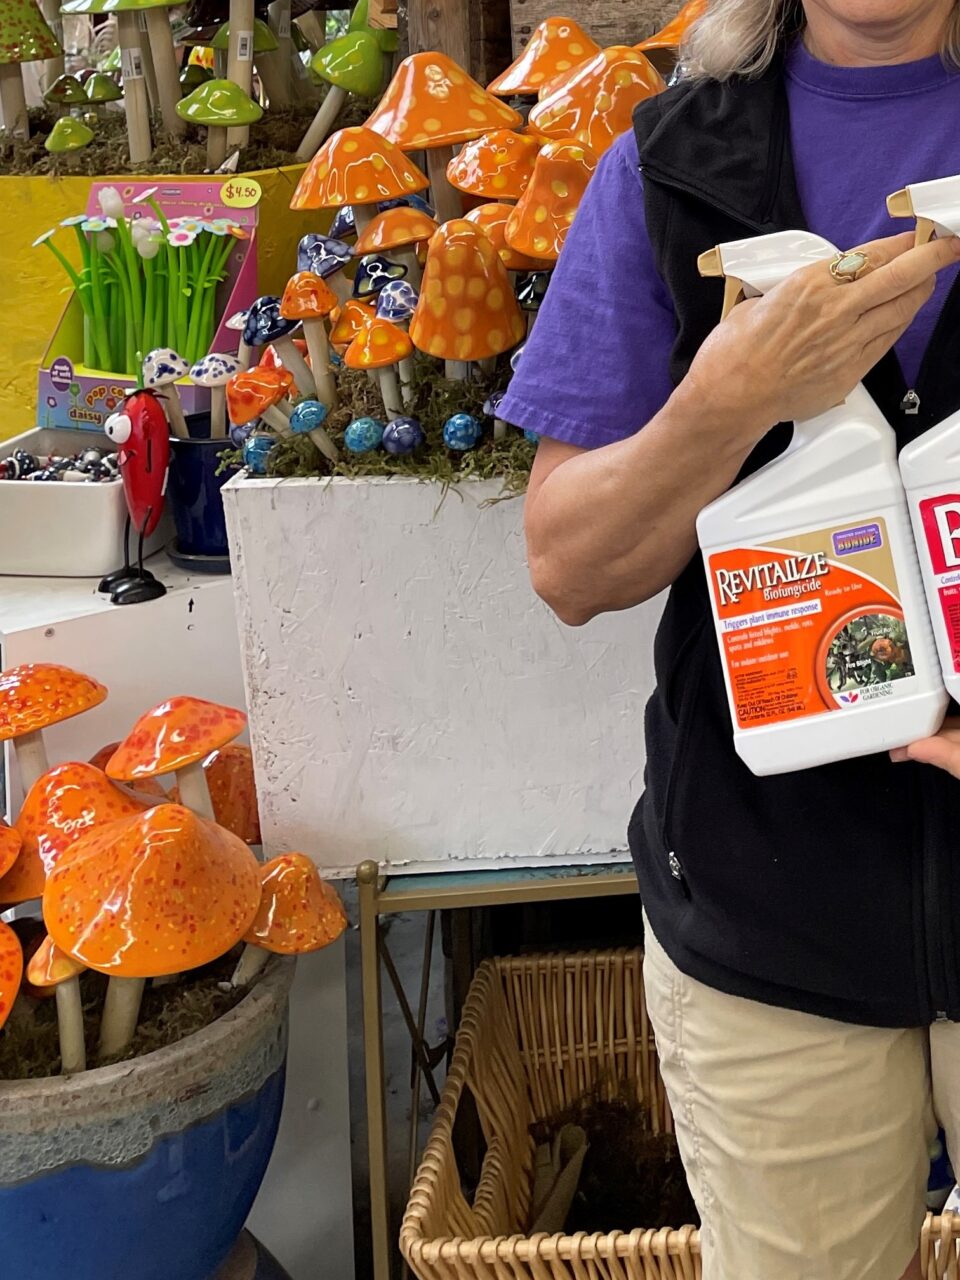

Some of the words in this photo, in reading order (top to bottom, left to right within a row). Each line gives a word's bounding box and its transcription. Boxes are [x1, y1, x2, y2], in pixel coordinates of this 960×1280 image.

[225, 183, 257, 199] $4.50
[86, 385, 107, 407] pop
[69, 408, 103, 425] daisy
[715, 552, 829, 605] REVITALIZE
[763, 579, 822, 600] Biofungicide
[824, 587, 843, 596] Ready
[851, 583, 862, 591] Use
[723, 618, 748, 630] Triggers
[749, 614, 765, 626] plant
[766, 610, 790, 620] immune
[791, 602, 819, 616] response
[862, 690, 893, 700] GARDENING
[870, 683, 893, 692] ORGANIC
